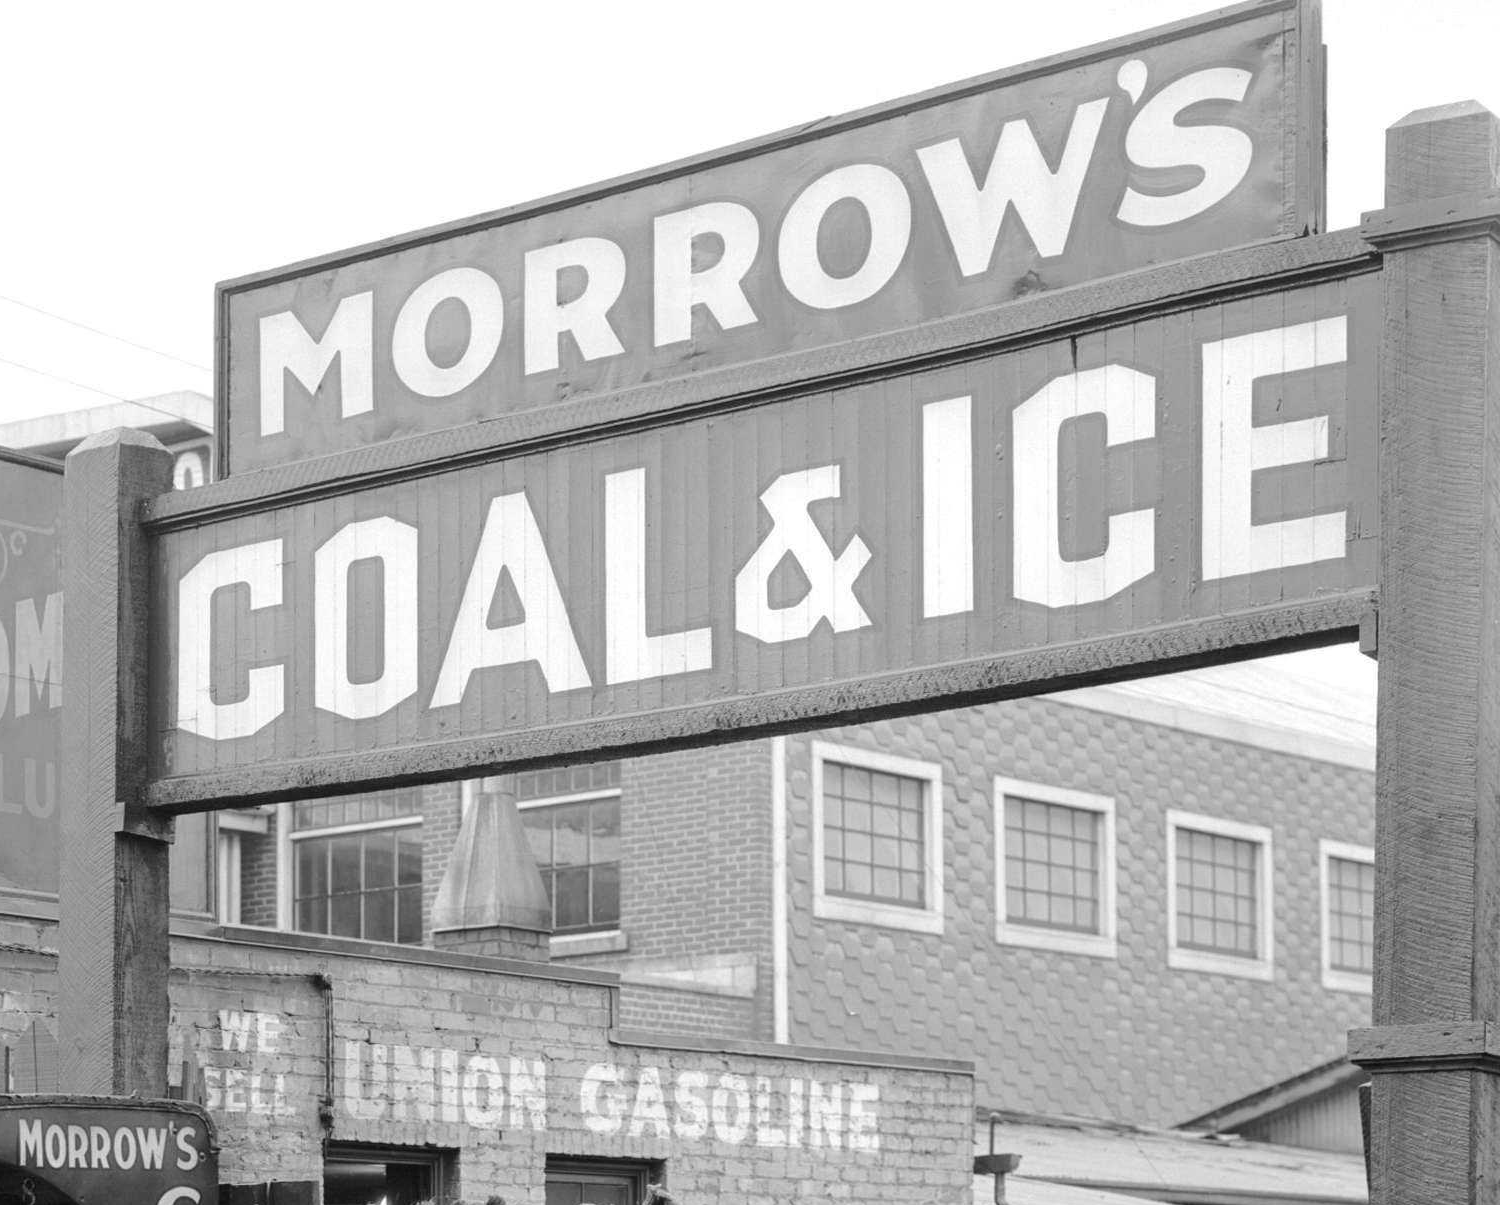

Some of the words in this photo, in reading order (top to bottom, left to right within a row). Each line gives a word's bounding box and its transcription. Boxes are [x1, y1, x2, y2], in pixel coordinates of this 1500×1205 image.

[259, 58, 1254, 437] MORROW'S
[177, 466, 713, 742] COAL
[734, 464, 873, 644] &
[922, 314, 1348, 619] ICE
[217, 1009, 281, 1053] WE
[18, 1118, 199, 1172] MORROW'S
[345, 1039, 547, 1132] UNION
[579, 1061, 881, 1154] GASOLINE
